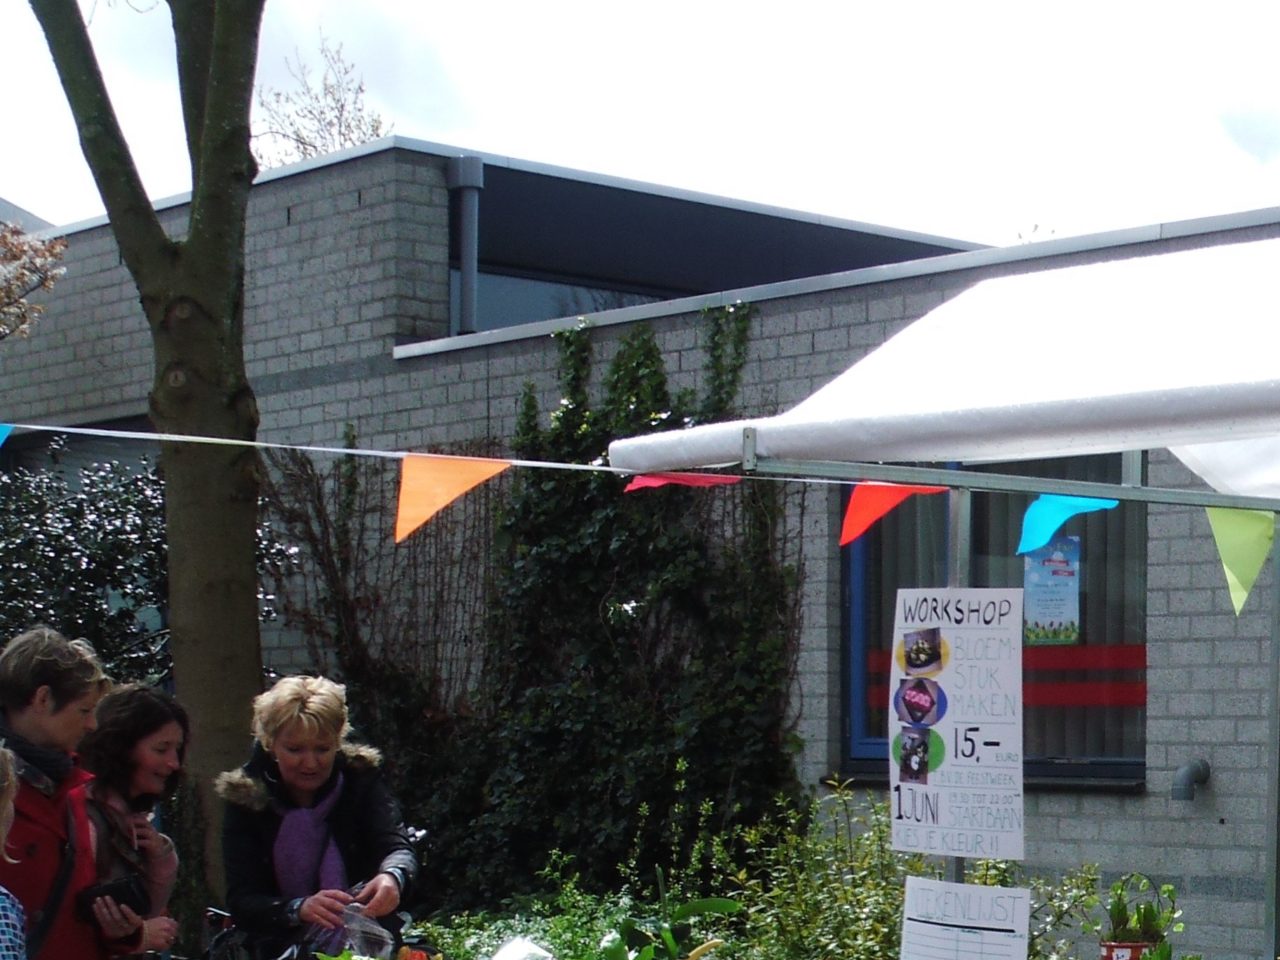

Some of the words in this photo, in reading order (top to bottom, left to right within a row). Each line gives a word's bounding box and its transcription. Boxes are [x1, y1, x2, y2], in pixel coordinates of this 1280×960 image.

[903, 598, 1012, 625] WORKSHOP
[954, 664, 1001, 690] STUK
[952, 693, 1016, 717] MAKEN
[995, 752, 1019, 763] EURO
[948, 805, 1022, 830] STARTBAAN
